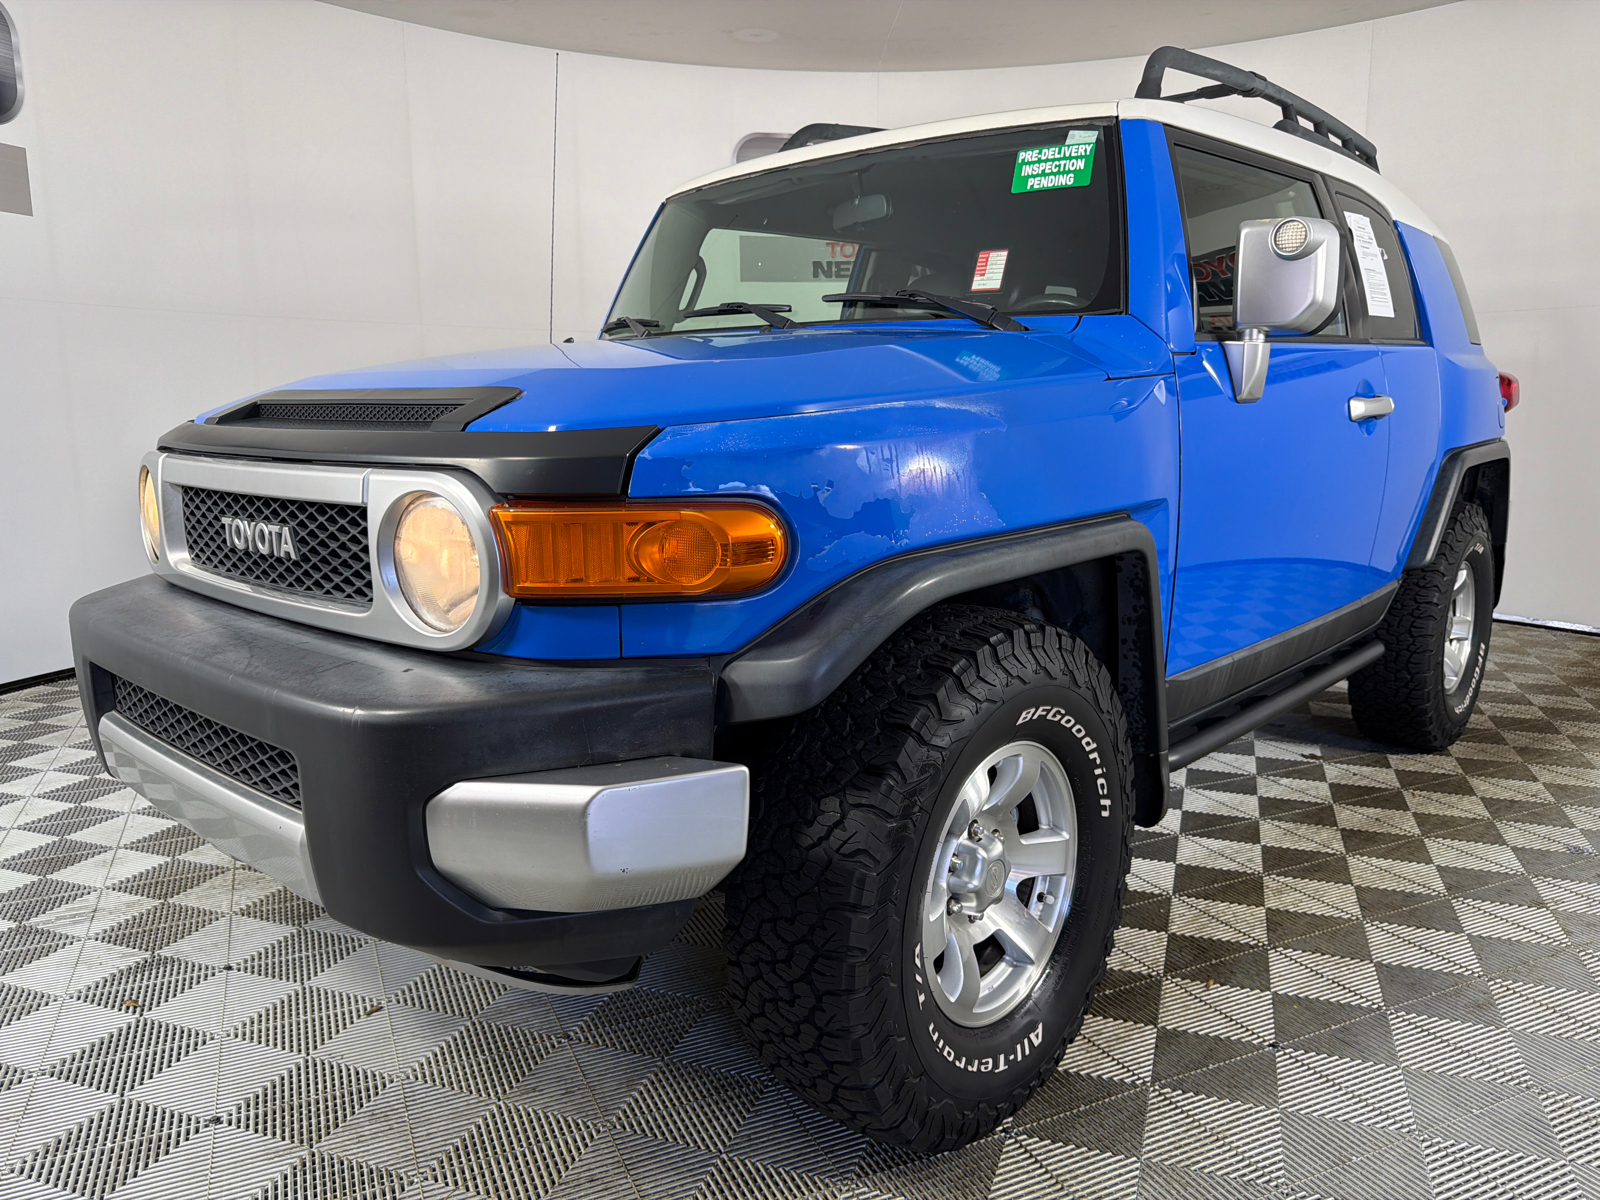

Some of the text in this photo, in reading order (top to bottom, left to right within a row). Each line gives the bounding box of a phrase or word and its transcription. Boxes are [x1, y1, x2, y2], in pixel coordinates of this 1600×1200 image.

[1018, 144, 1093, 163] PRE-DELIVERY
[1021, 159, 1085, 176] INSPECTION
[1027, 173, 1074, 189] PENDING
[826, 242, 859, 259] TO
[222, 516, 298, 560] TOYOTA
[1016, 706, 1111, 817] BFGoodrich
[914, 942, 1043, 1073] All-Terrain T/A
